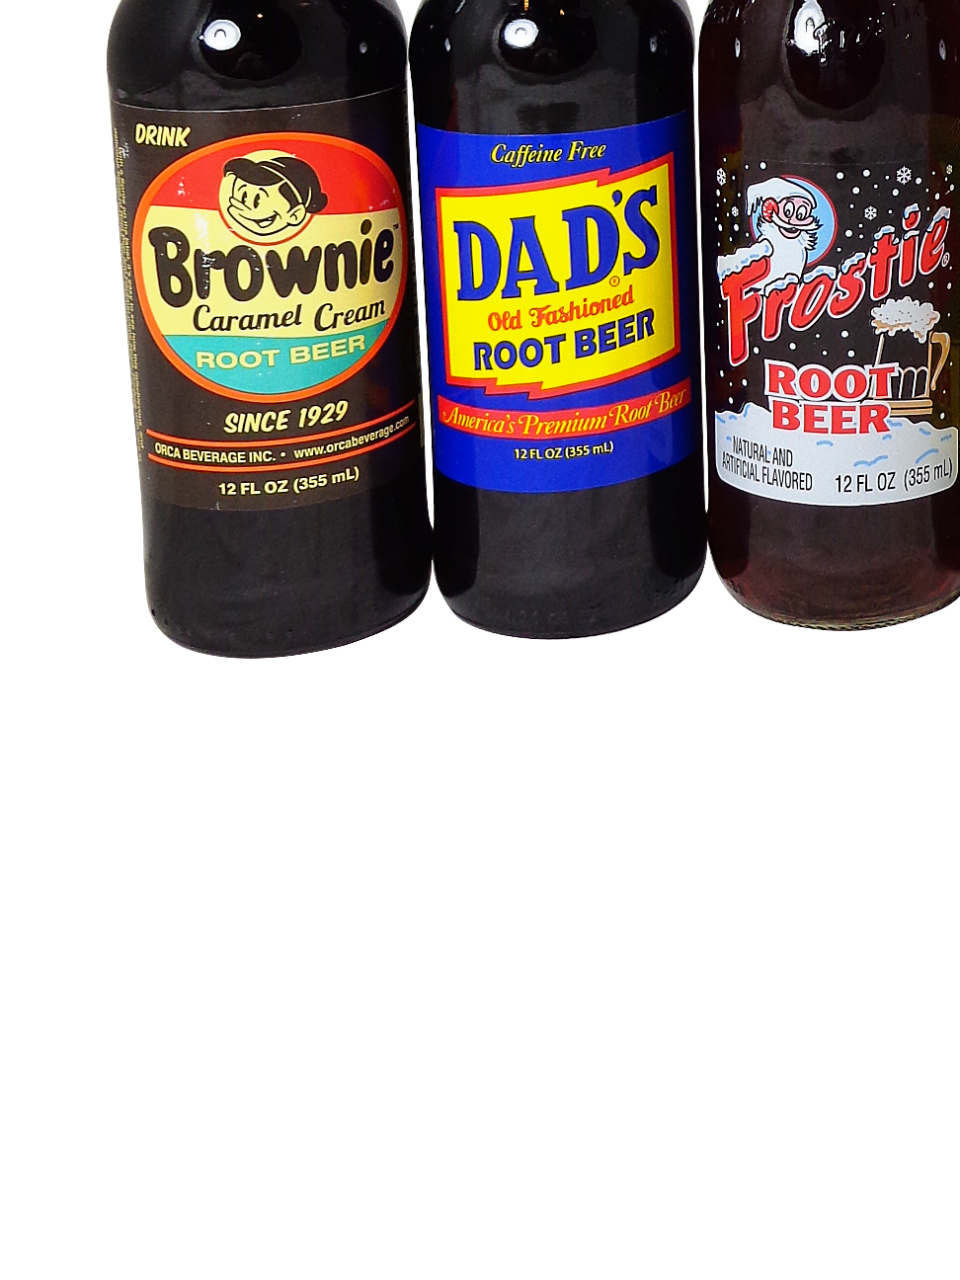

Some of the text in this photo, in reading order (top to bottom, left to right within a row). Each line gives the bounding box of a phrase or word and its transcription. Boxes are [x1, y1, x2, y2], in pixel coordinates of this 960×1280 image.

[136, 123, 191, 148] DRINK
[490, 141, 607, 168] Caffeine Free
[453, 184, 661, 301] DAD'S
[148, 219, 395, 308] Brownie
[718, 203, 951, 367] Frostie
[192, 300, 386, 332] Caramel Cream
[487, 284, 635, 332] Old Fashioned
[197, 334, 366, 369] ROOT BEER
[473, 308, 655, 371] ROOT BEER
[764, 359, 899, 400] ROOT
[224, 400, 349, 434] SINCE 1929
[442, 406, 515, 435] America's
[517, 414, 609, 436] Premium
[608, 402, 653, 427] Root
[653, 387, 687, 415] Beer
[769, 399, 891, 434] BEER
[155, 416, 410, 463] ORCA BEVERAGE INC. www.orcabeverage.com
[513, 441, 614, 460] 12 FL OZ (355 mL)
[732, 435, 793, 467] NATURAL AND
[218, 466, 360, 496] 12 FL OZ (355 mL)
[722, 453, 813, 492] ARTIFICIAL FLAVORED
[835, 456, 953, 493] 12 FL OZ (355 mL)
